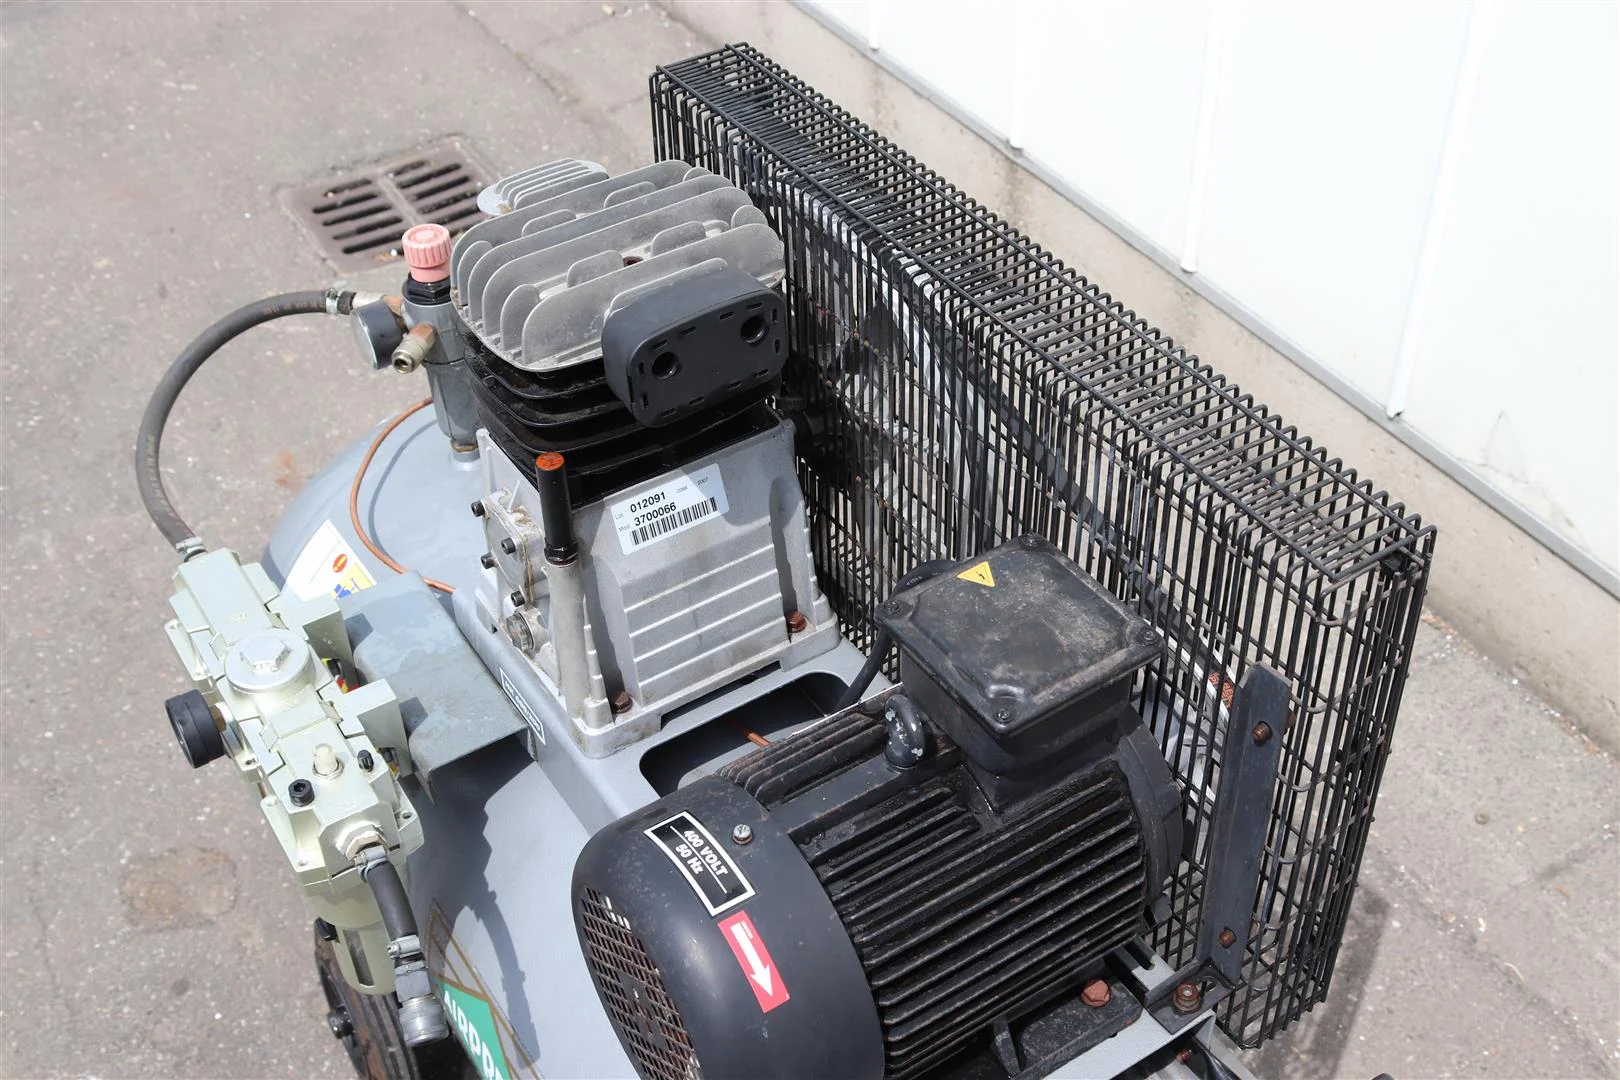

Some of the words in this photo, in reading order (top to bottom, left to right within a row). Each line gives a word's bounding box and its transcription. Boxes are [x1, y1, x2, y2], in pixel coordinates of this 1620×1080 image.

[630, 491, 666, 513] 012091
[634, 502, 677, 527] 3700066
[675, 843, 693, 858] 50
[686, 856, 704, 875] Hz
[684, 830, 704, 848] 400
[700, 845, 729, 876] VOLT
[444, 989, 504, 1080] AIRPR
